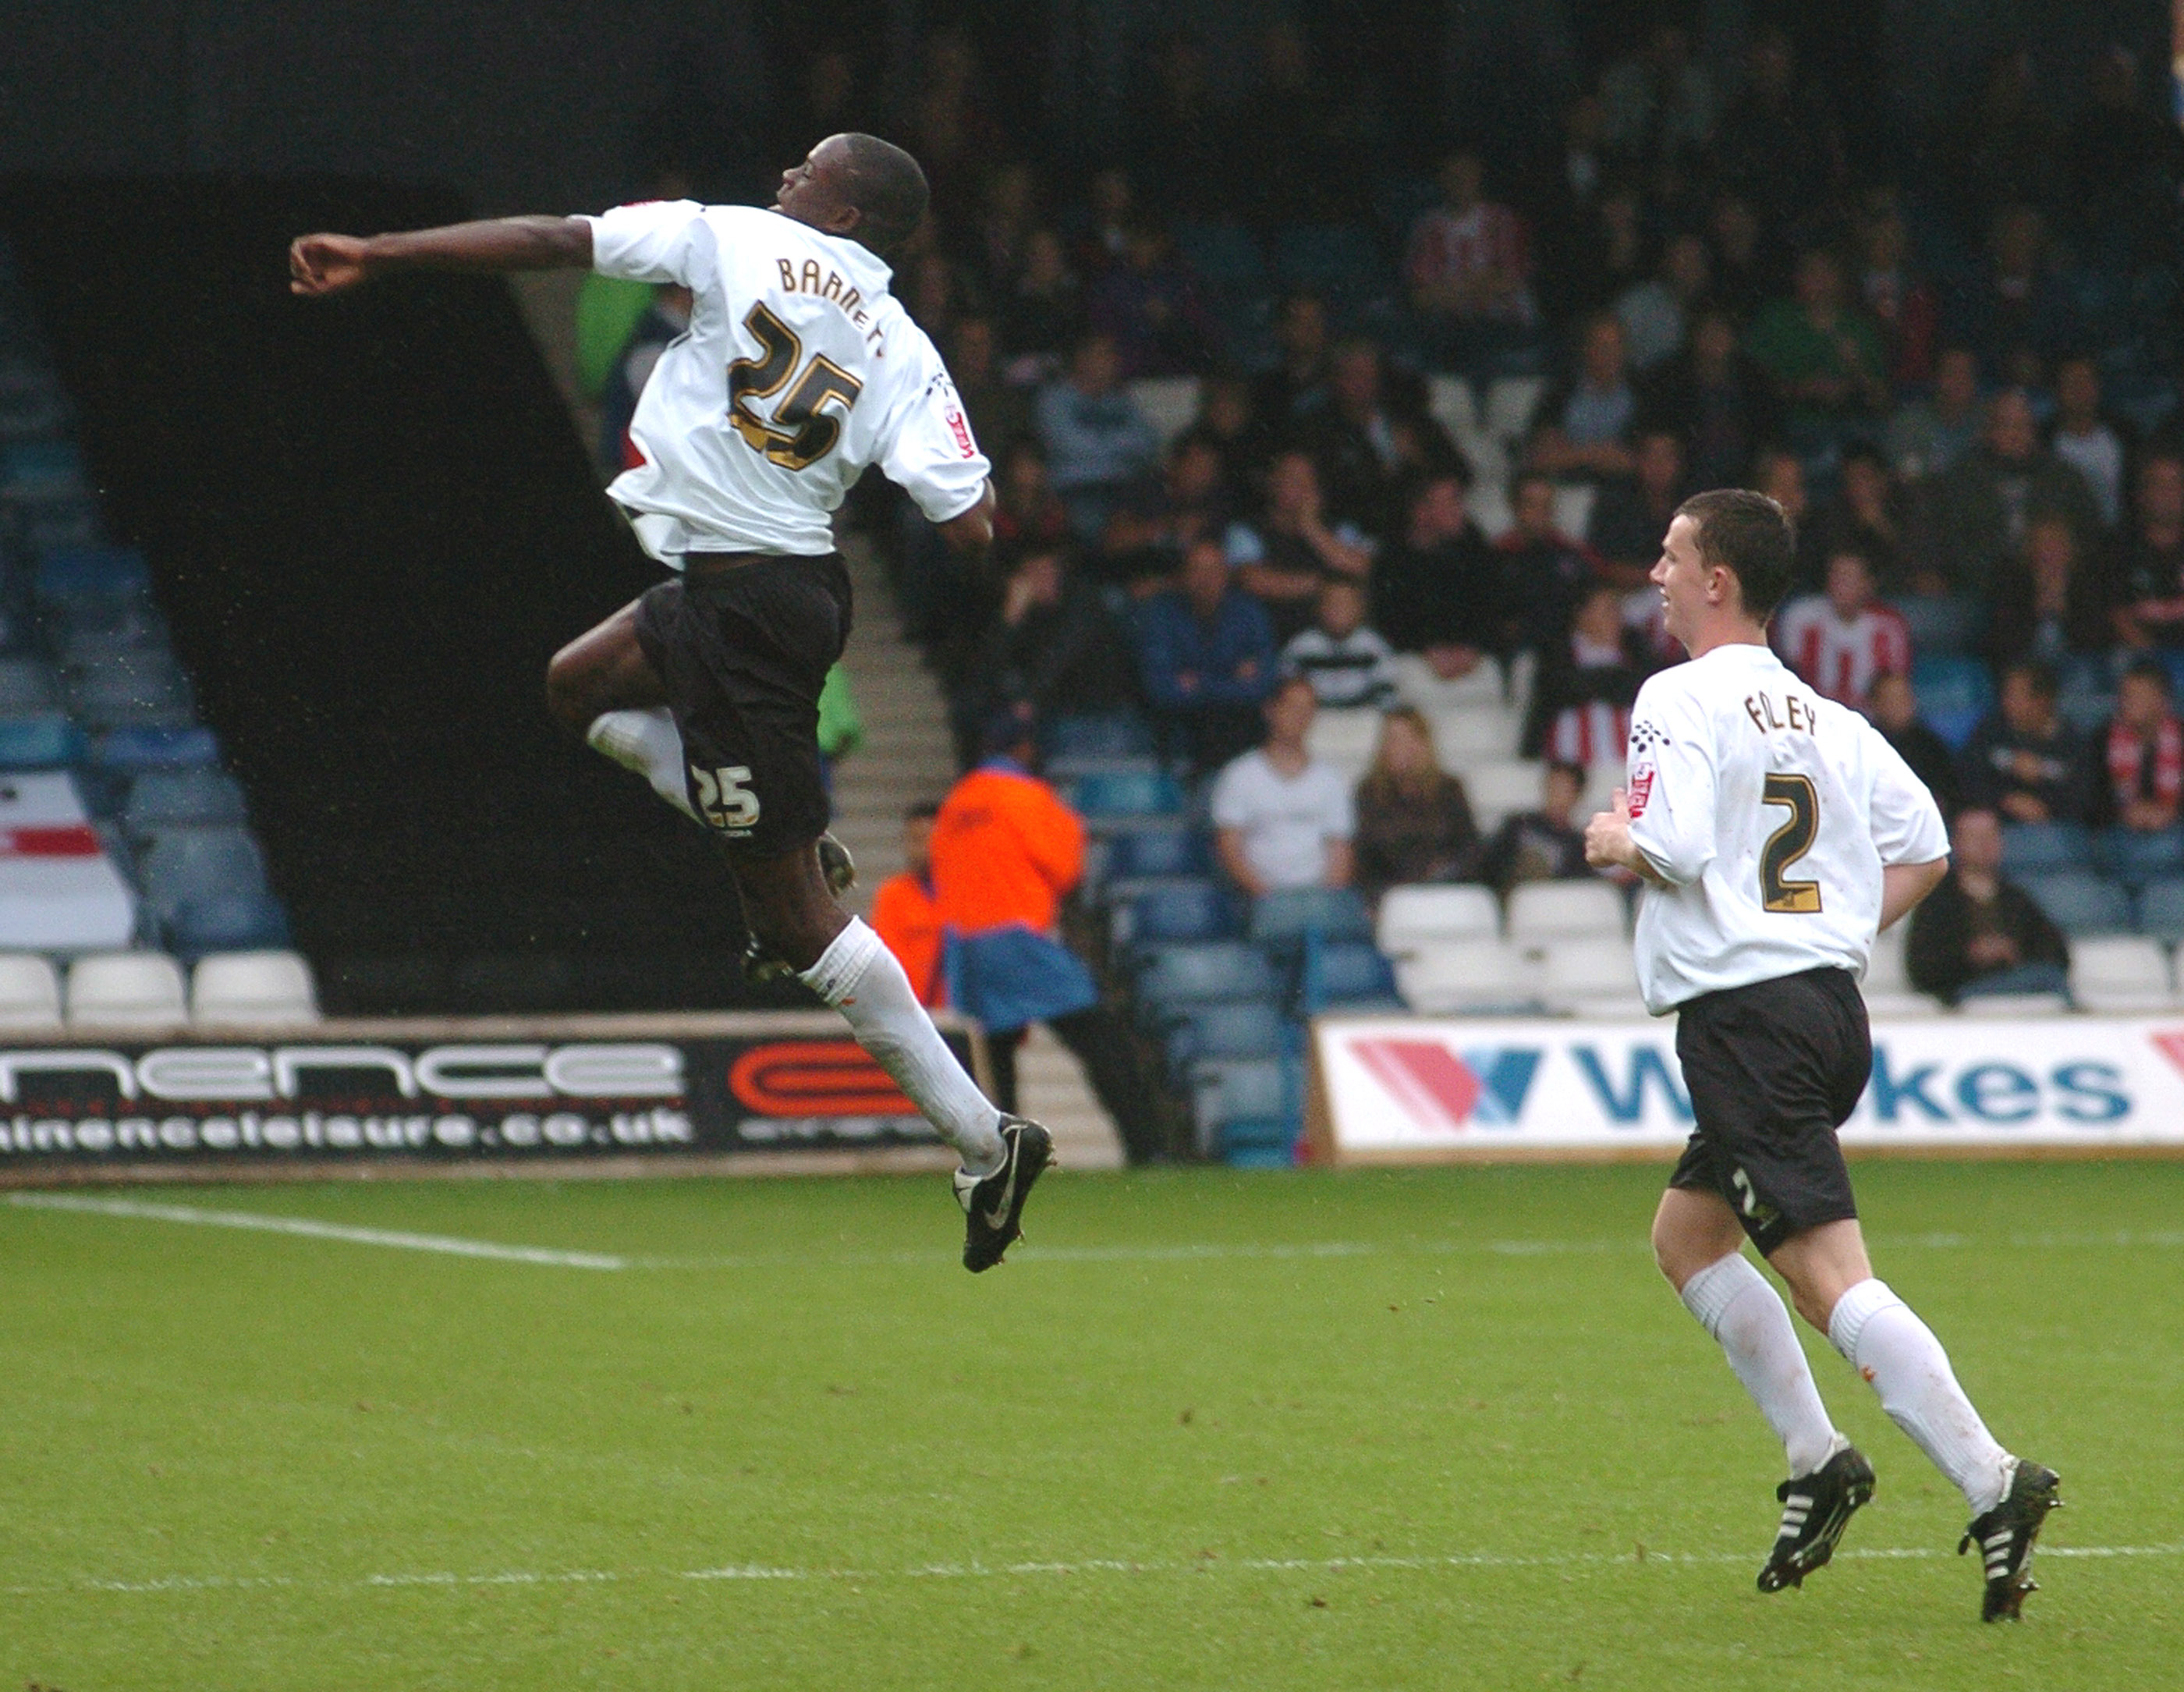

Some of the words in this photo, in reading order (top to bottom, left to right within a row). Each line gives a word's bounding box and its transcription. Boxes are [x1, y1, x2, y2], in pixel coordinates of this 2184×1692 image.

[775, 258, 884, 358] BARNET
[728, 300, 864, 472] 25
[690, 764, 760, 828] 25
[1759, 772, 1823, 913] 2
[1568, 1039, 2133, 1125] Wkes
